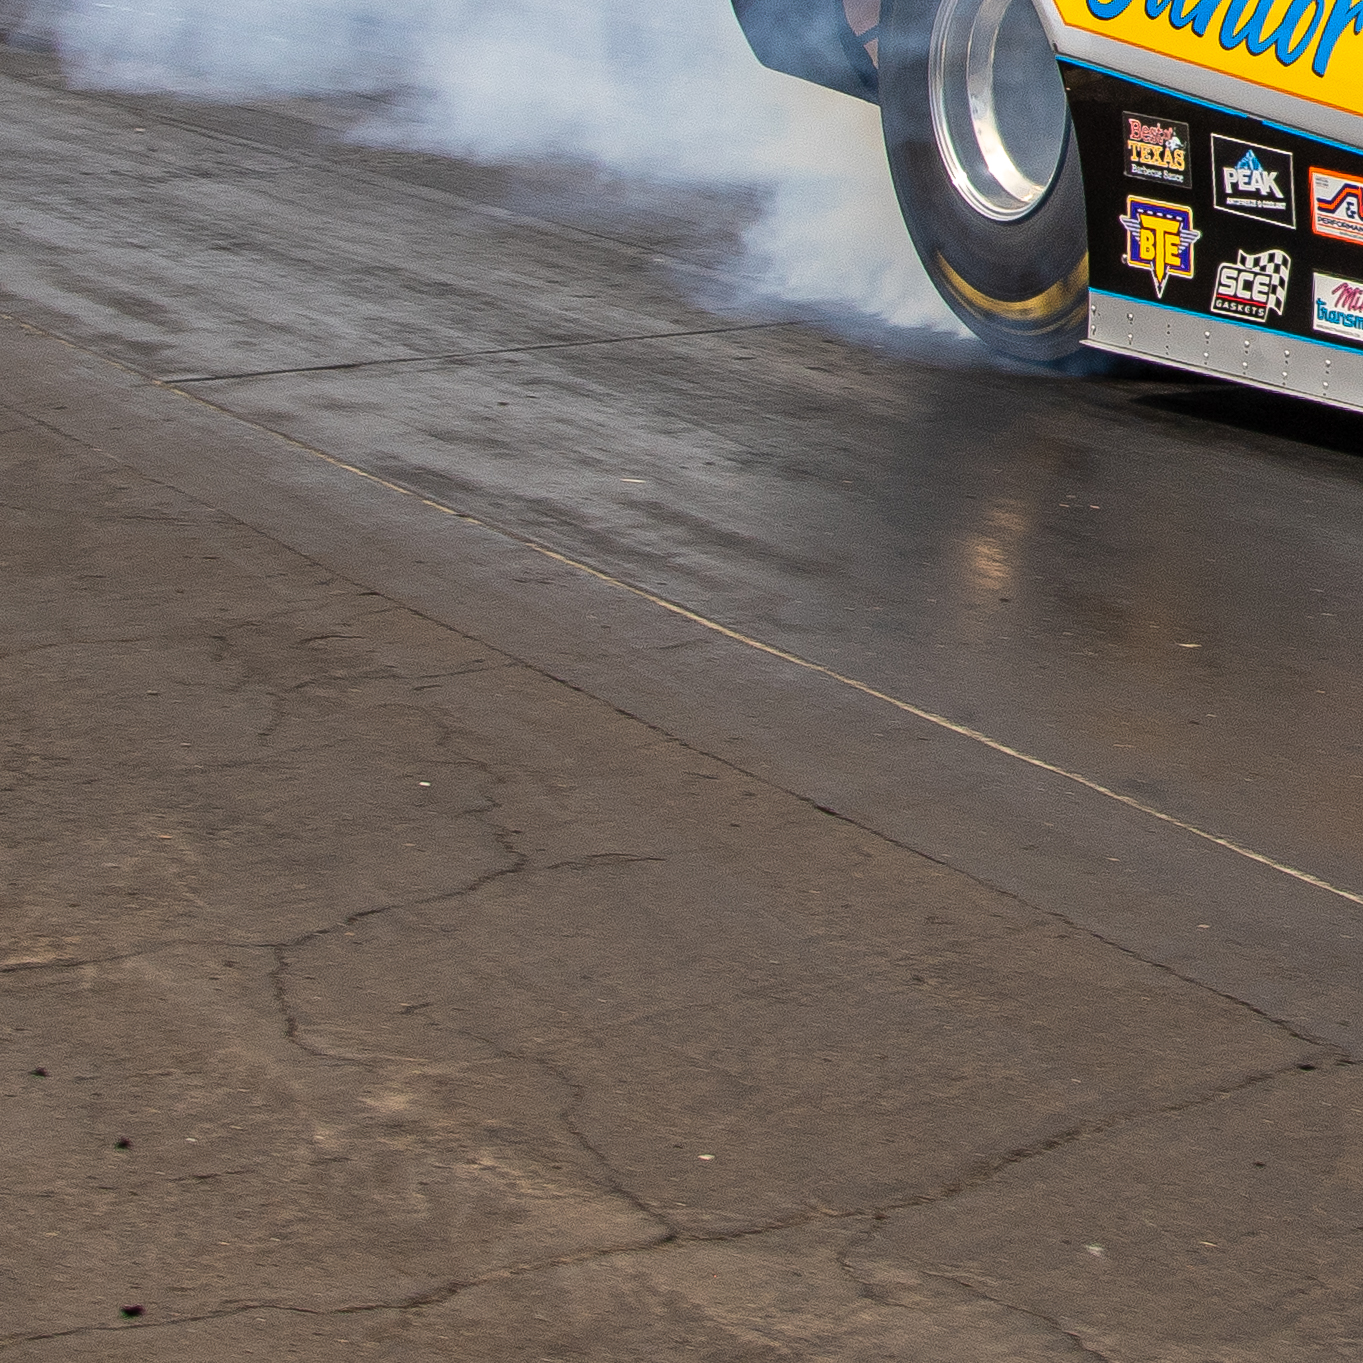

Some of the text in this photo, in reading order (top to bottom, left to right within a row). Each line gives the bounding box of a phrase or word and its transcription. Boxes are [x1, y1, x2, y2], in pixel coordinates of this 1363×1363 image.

[1127, 140, 1185, 171] TEXAS
[1223, 167, 1284, 198] PEAK
[1217, 268, 1270, 302] SCE
[1215, 298, 1266, 318] GASKETS
